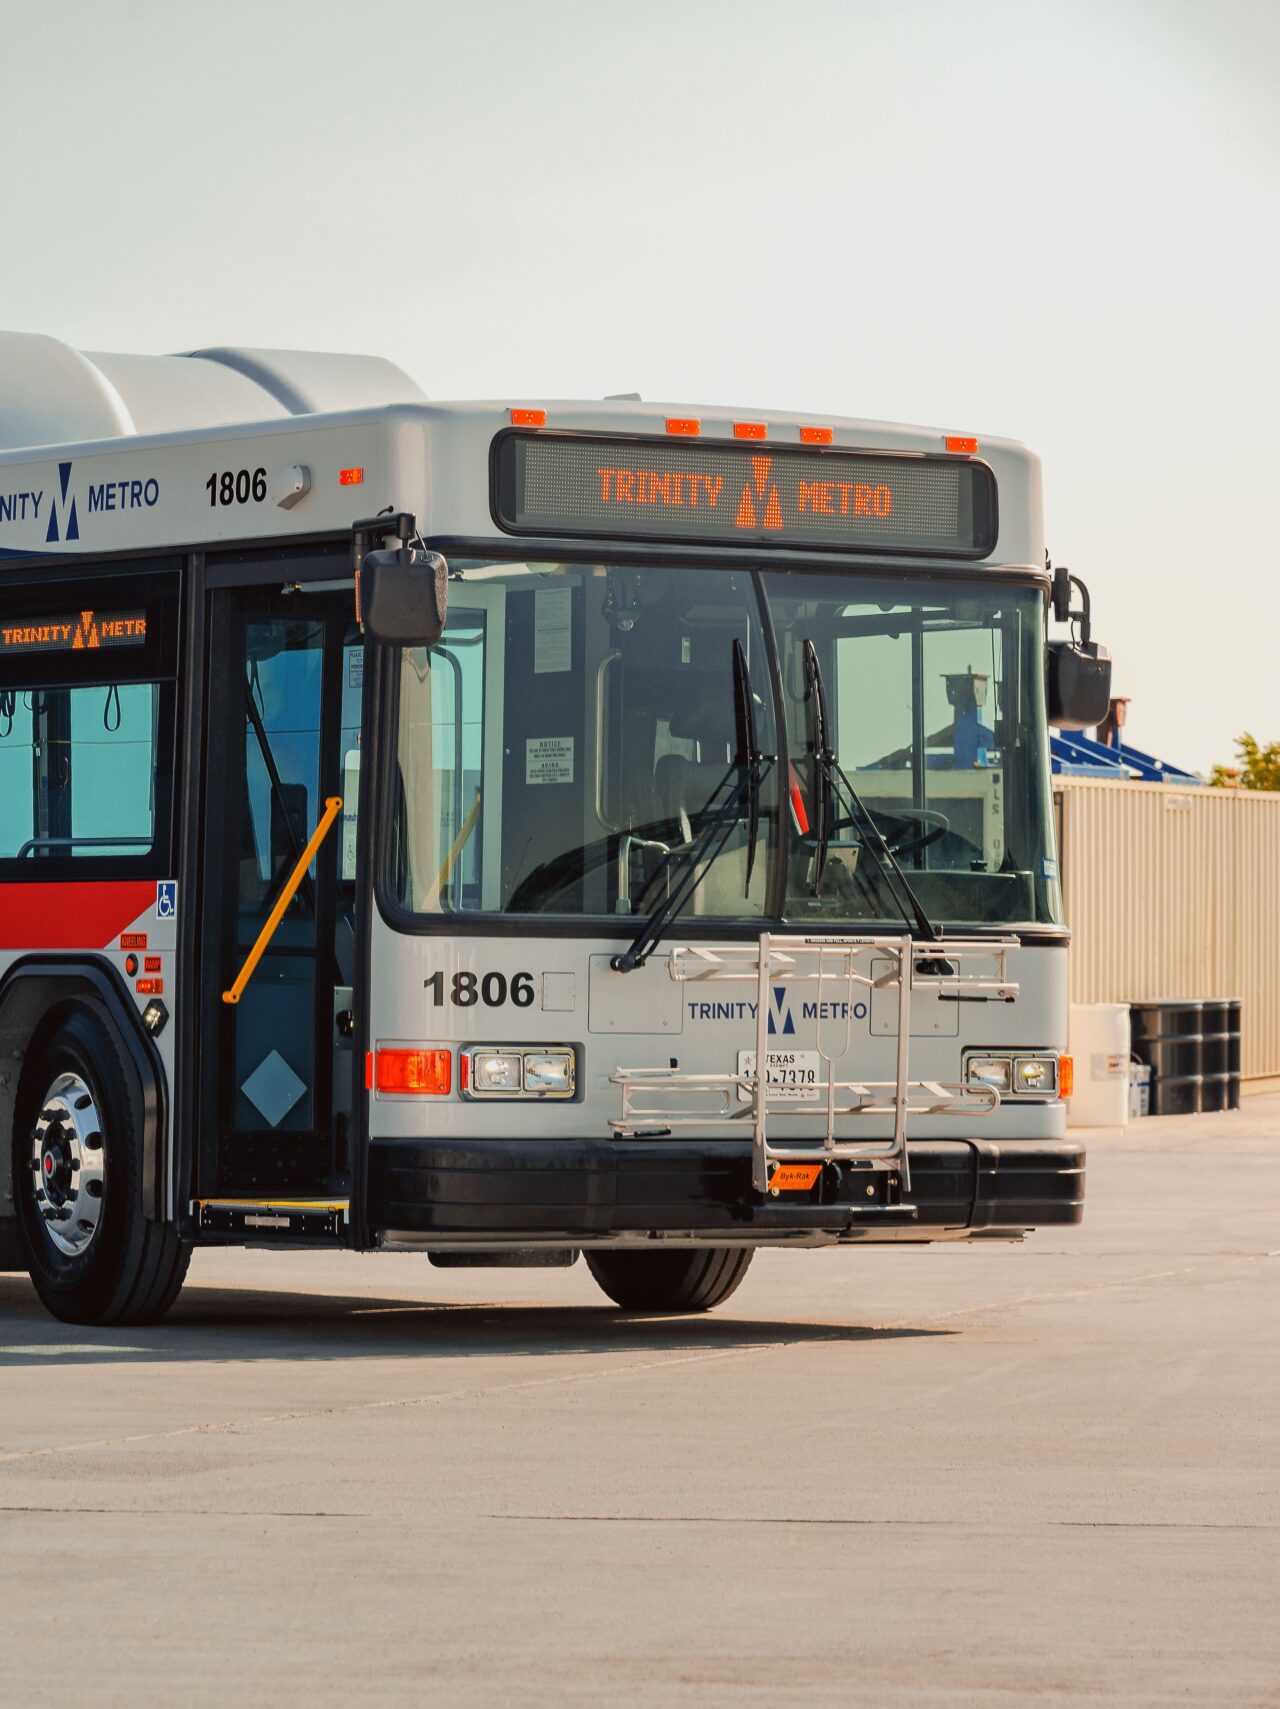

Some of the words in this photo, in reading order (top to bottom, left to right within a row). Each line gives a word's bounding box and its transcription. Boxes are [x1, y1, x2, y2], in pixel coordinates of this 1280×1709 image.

[88, 478, 160, 513] METRO
[206, 467, 267, 507] 1806
[596, 467, 724, 508] TRINITY
[798, 479, 892, 518] METRO
[2, 623, 71, 646] TRINITY
[423, 971, 535, 1007] 1806
[688, 1002, 758, 1019] TRINITY
[802, 1002, 867, 1019] METRO
[766, 1054, 795, 1064] TEXAS
[780, 1172, 810, 1180] Byk-Rak
